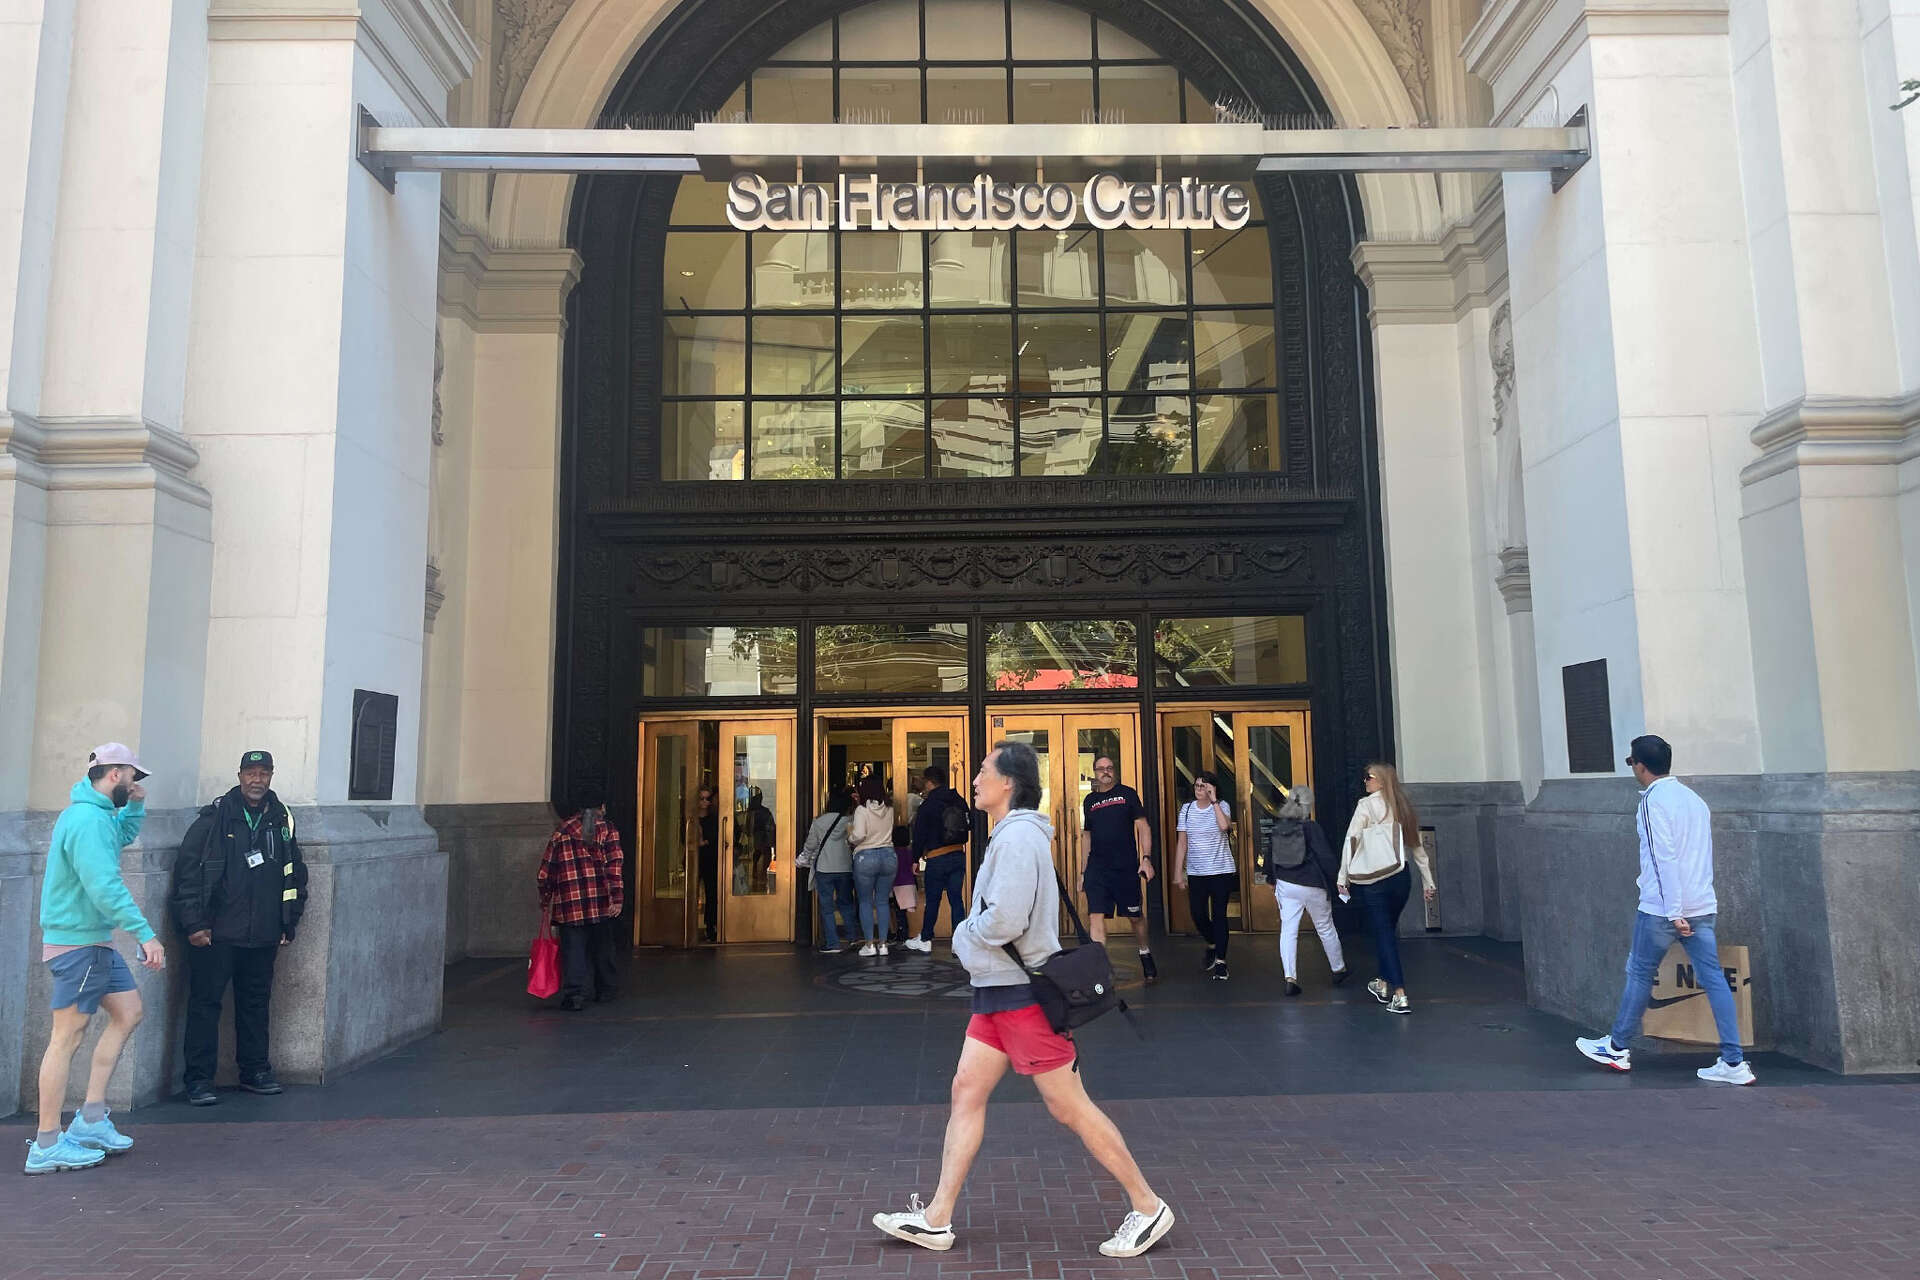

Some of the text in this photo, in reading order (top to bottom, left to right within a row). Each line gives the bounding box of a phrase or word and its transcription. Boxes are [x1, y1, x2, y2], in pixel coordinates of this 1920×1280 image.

[726, 171, 1250, 230] San Francisco Centre
[1676, 963, 1737, 993] NE
